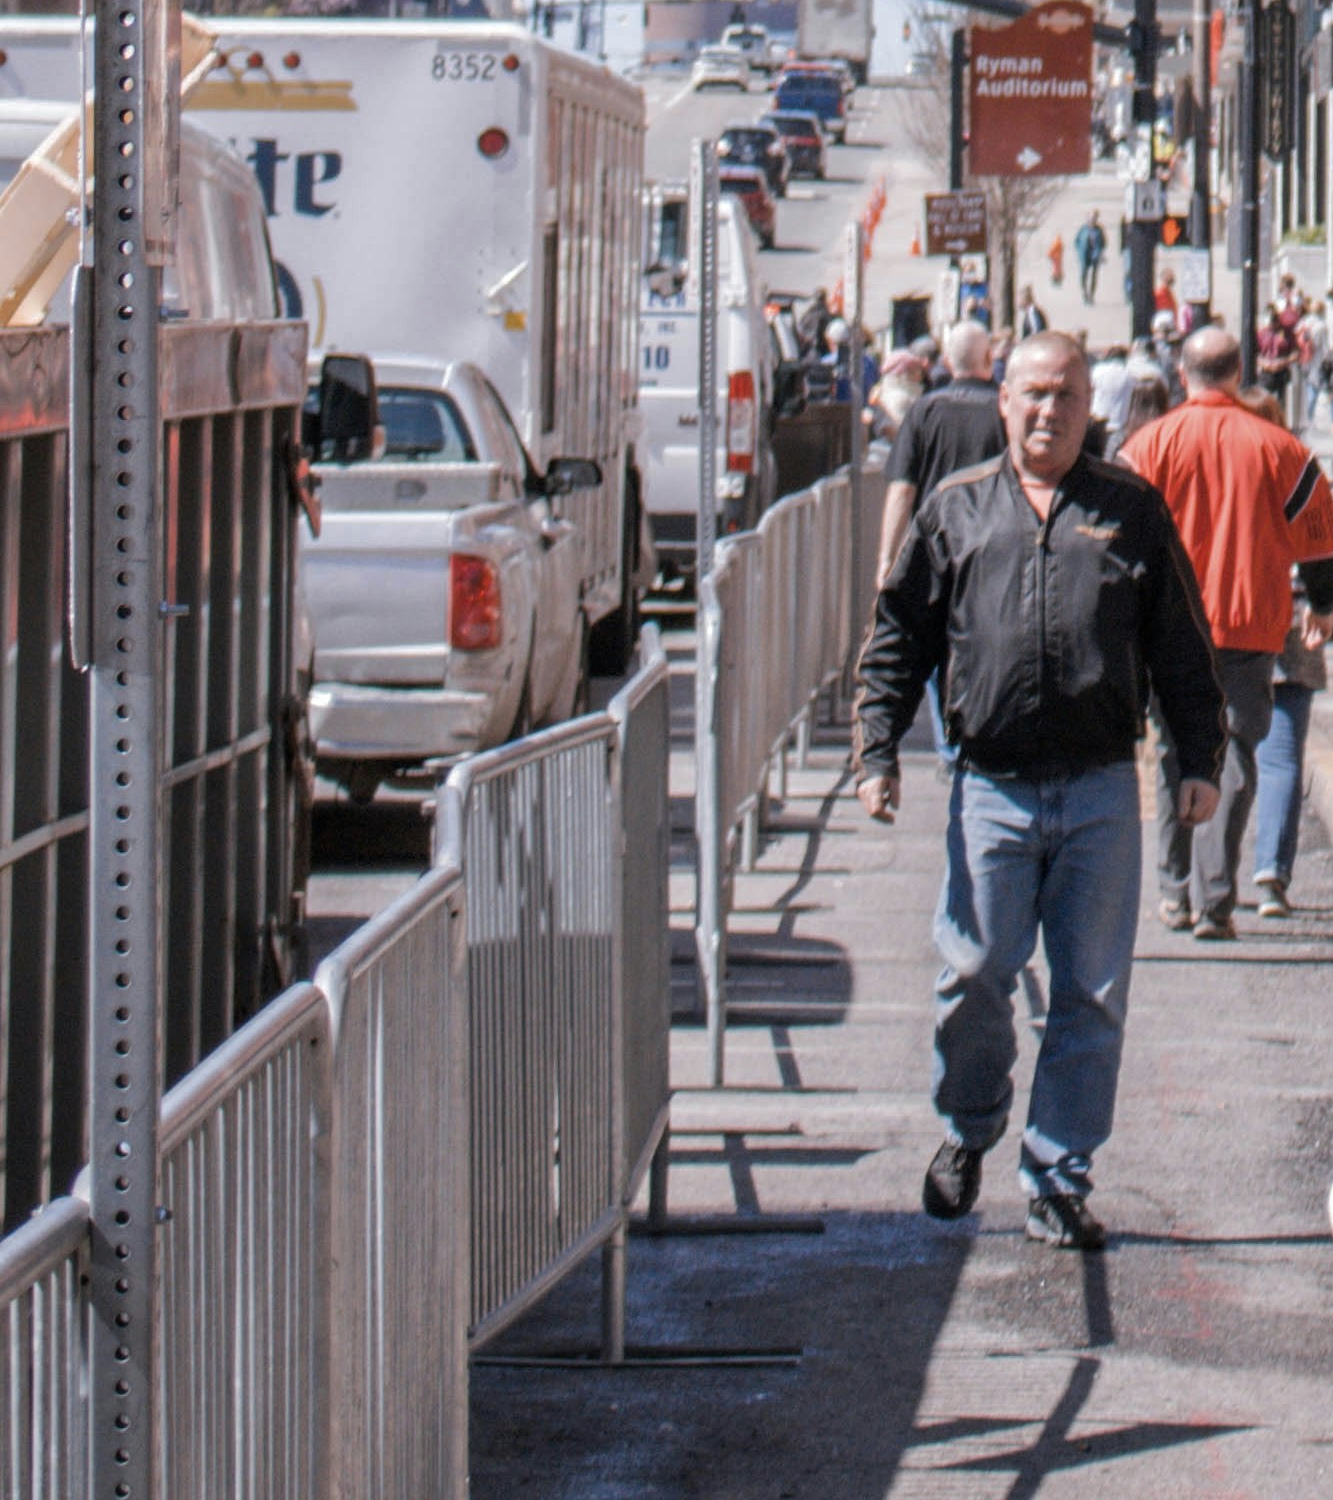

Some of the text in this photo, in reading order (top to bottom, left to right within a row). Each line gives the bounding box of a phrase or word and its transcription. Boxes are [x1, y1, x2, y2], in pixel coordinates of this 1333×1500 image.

[430, 53, 497, 82] 8352
[976, 54, 1043, 78] Ryman
[976, 77, 1088, 99] Auditorium
